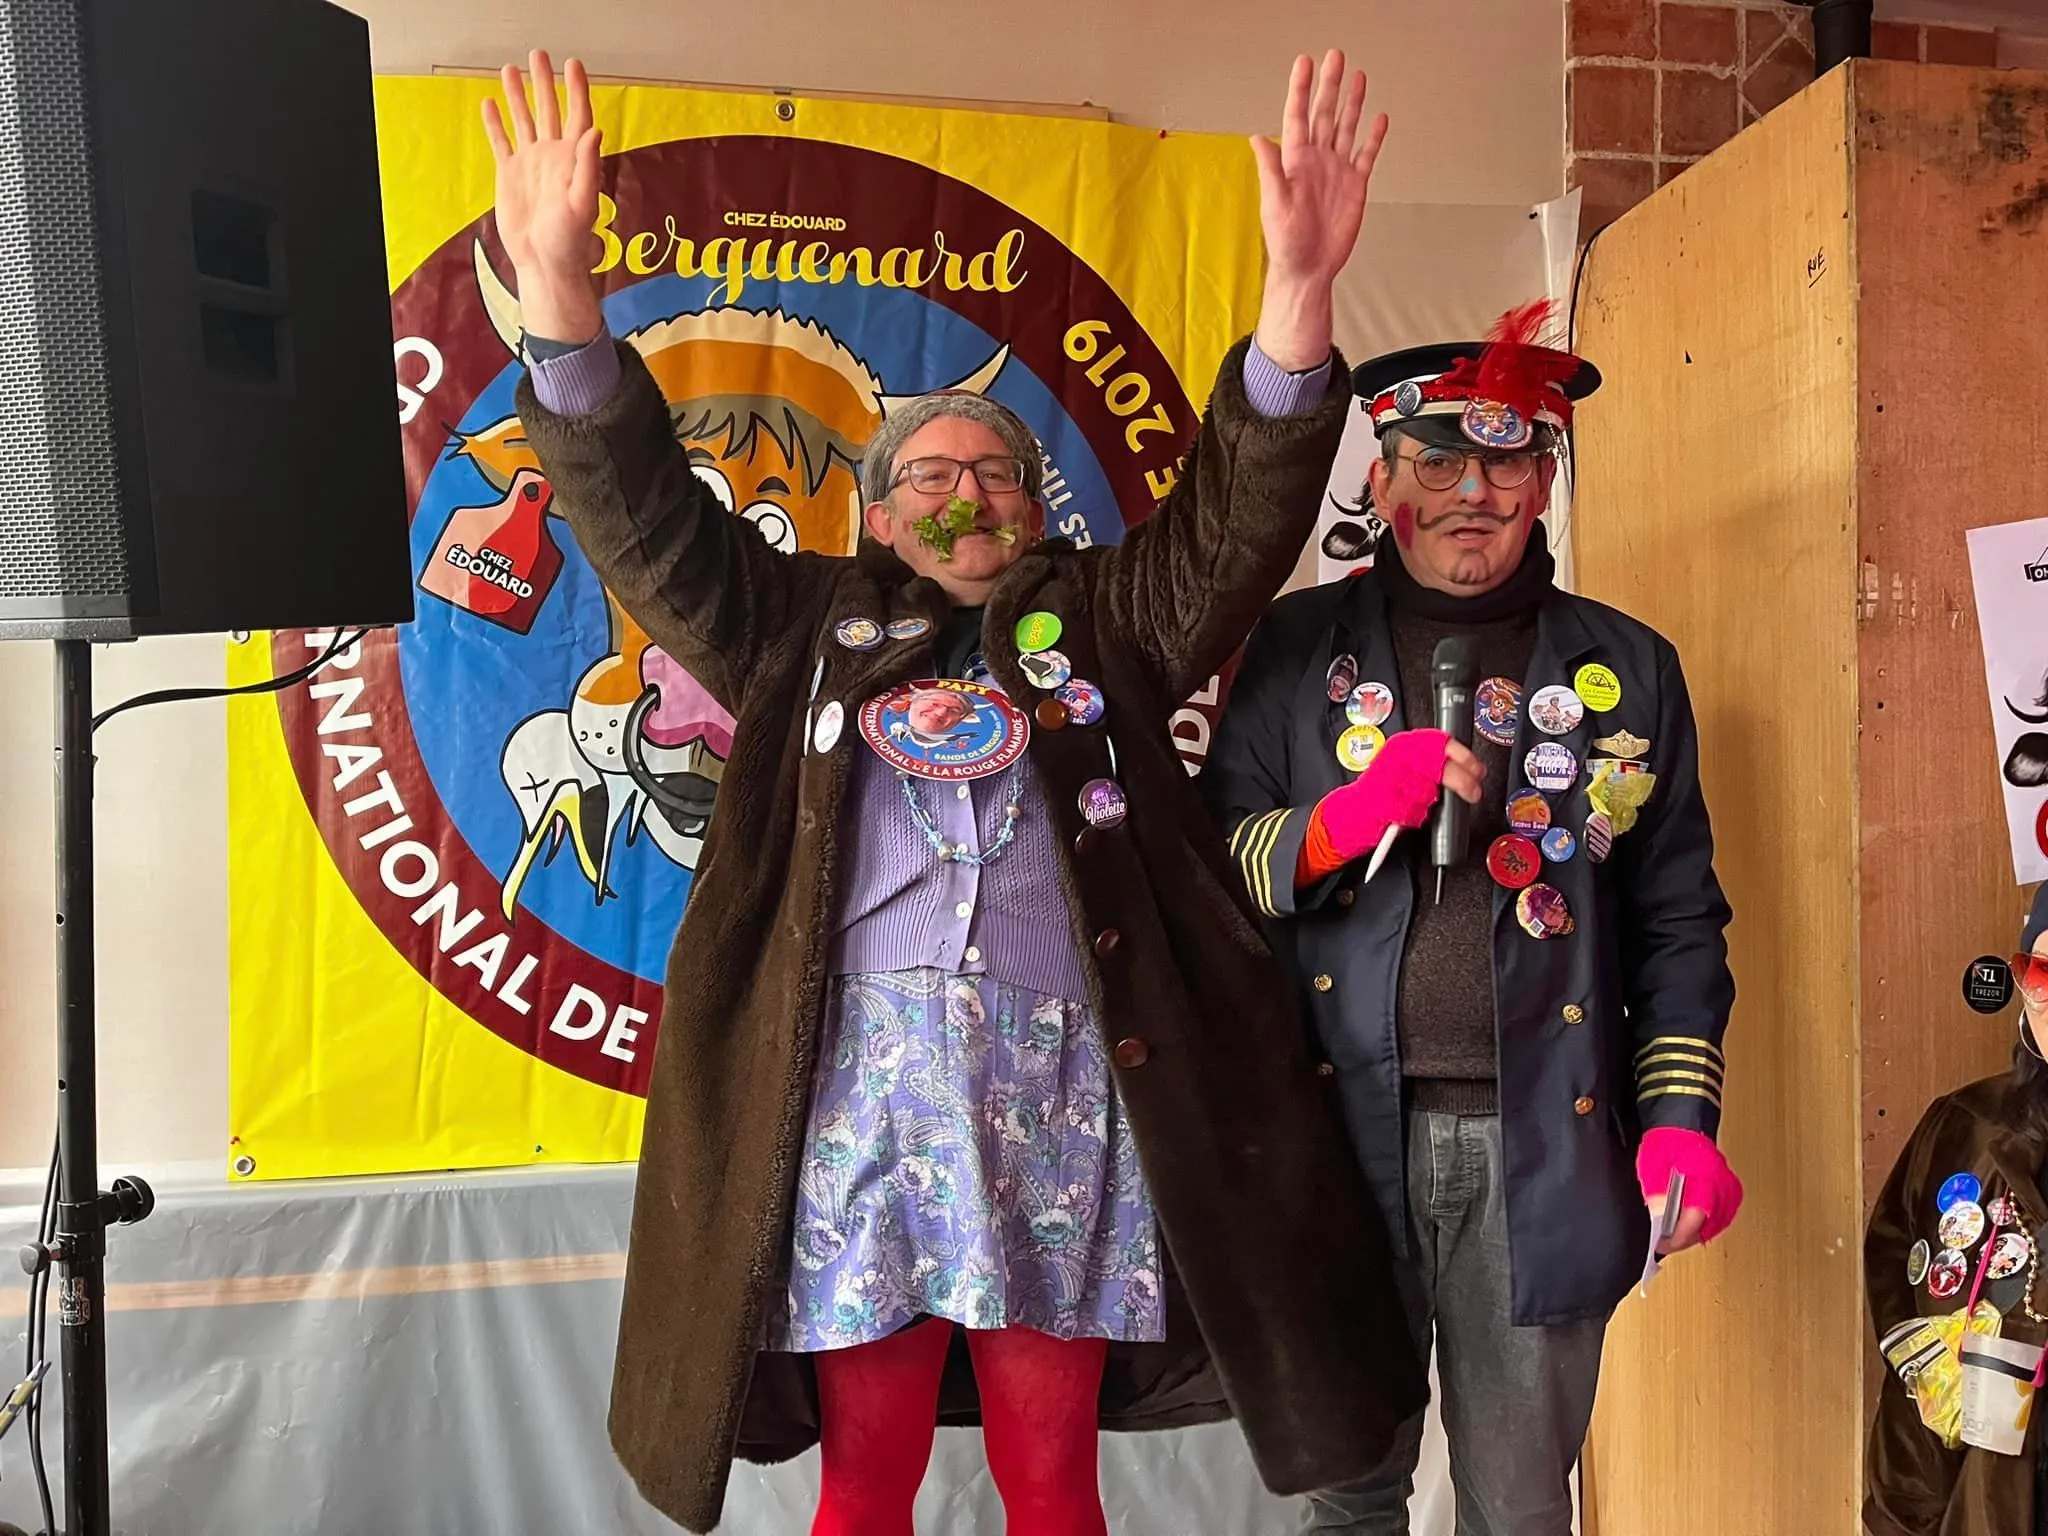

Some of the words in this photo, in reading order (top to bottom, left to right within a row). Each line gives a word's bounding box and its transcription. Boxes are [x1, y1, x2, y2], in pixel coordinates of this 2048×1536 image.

[723, 211, 768, 228] CHEZ
[769, 210, 847, 232] ÉDOUARD
[590, 191, 1029, 308] Berguenard
[1062, 318, 1176, 454] 2019
[444, 544, 534, 600] ÉDOUARD
[479, 547, 513, 571] CHEZ
[936, 680, 993, 696] PAPY
[864, 700, 910, 767] INTERNATIONAL
[932, 766, 951, 777] LA
[952, 760, 1000, 777] ROUGE
[996, 717, 1025, 763] FLAMANDE
[933, 753, 967, 762] BANDE
[1085, 800, 1125, 825] Violette
[548, 982, 649, 1063] DE
